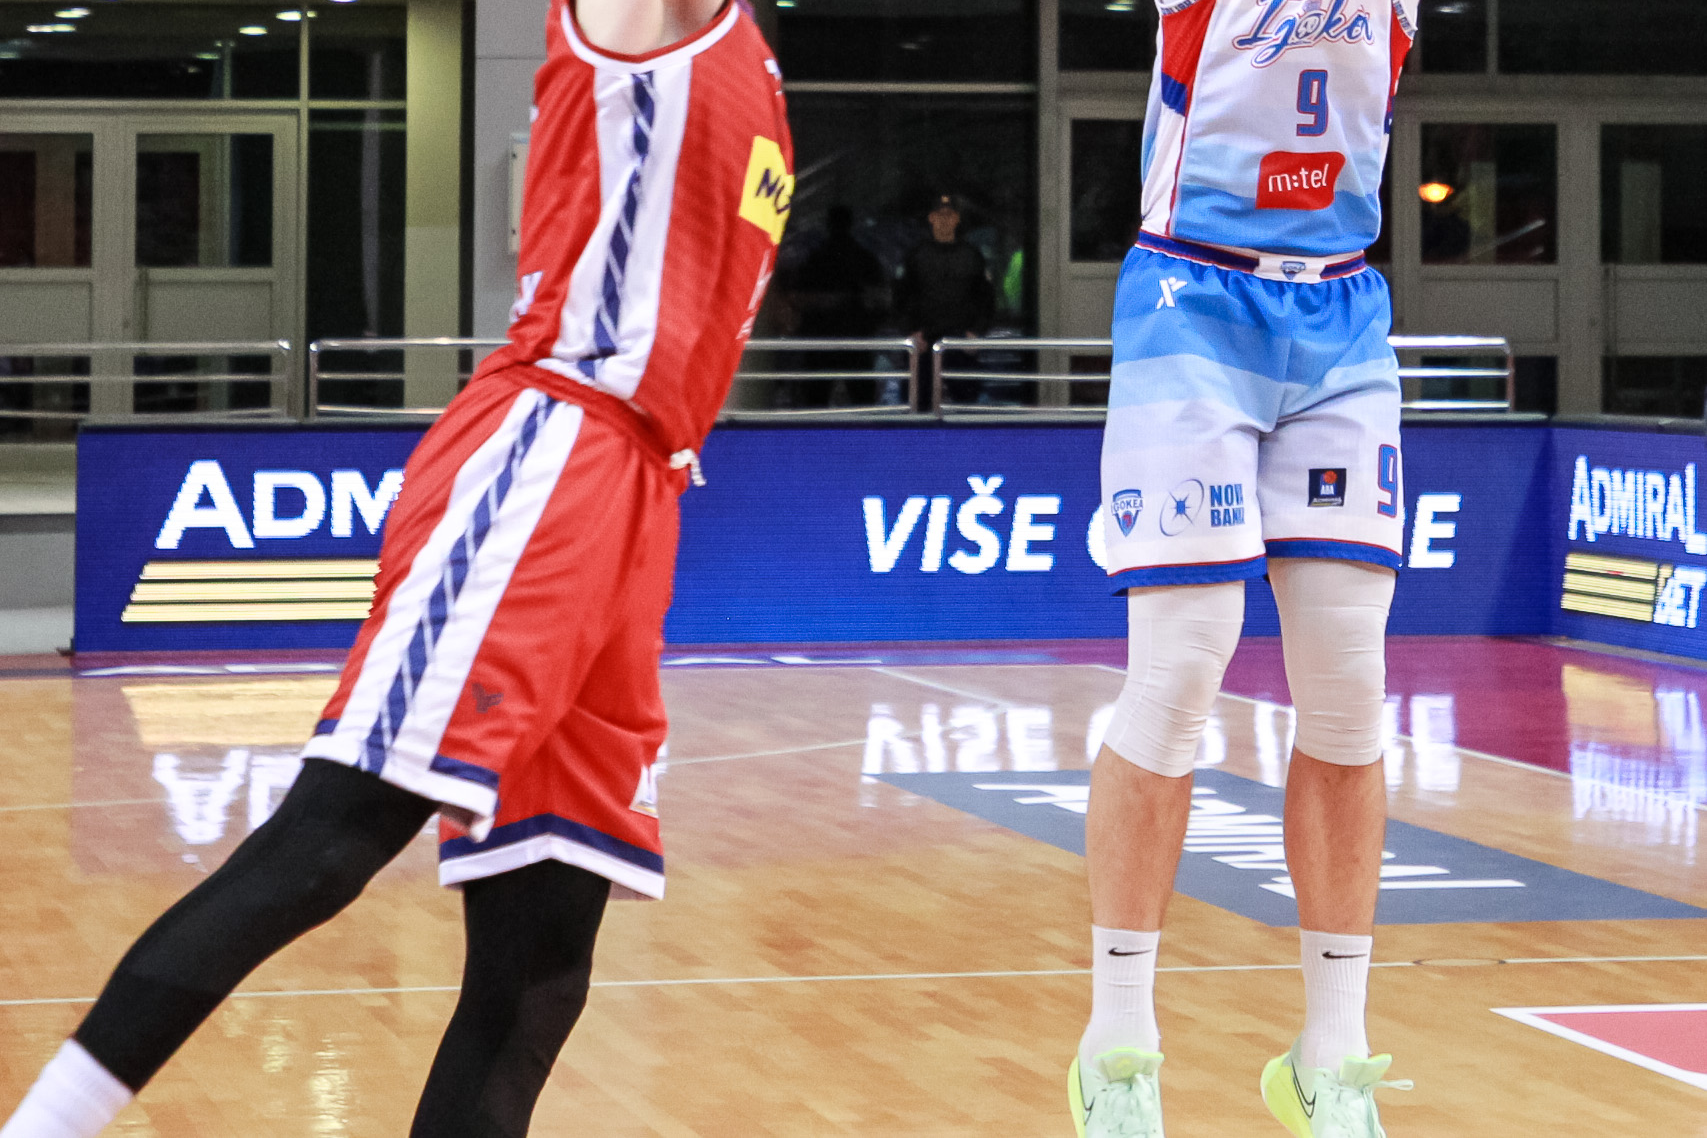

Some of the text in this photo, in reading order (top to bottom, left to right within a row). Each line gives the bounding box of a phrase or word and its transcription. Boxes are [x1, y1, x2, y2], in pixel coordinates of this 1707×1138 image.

[1296, 69, 1329, 137] 9
[1268, 163, 1329, 192] m:tel
[1377, 443, 1398, 518] 9
[1567, 453, 1707, 556] ADMIRAL
[861, 474, 1061, 574] VIŠE
